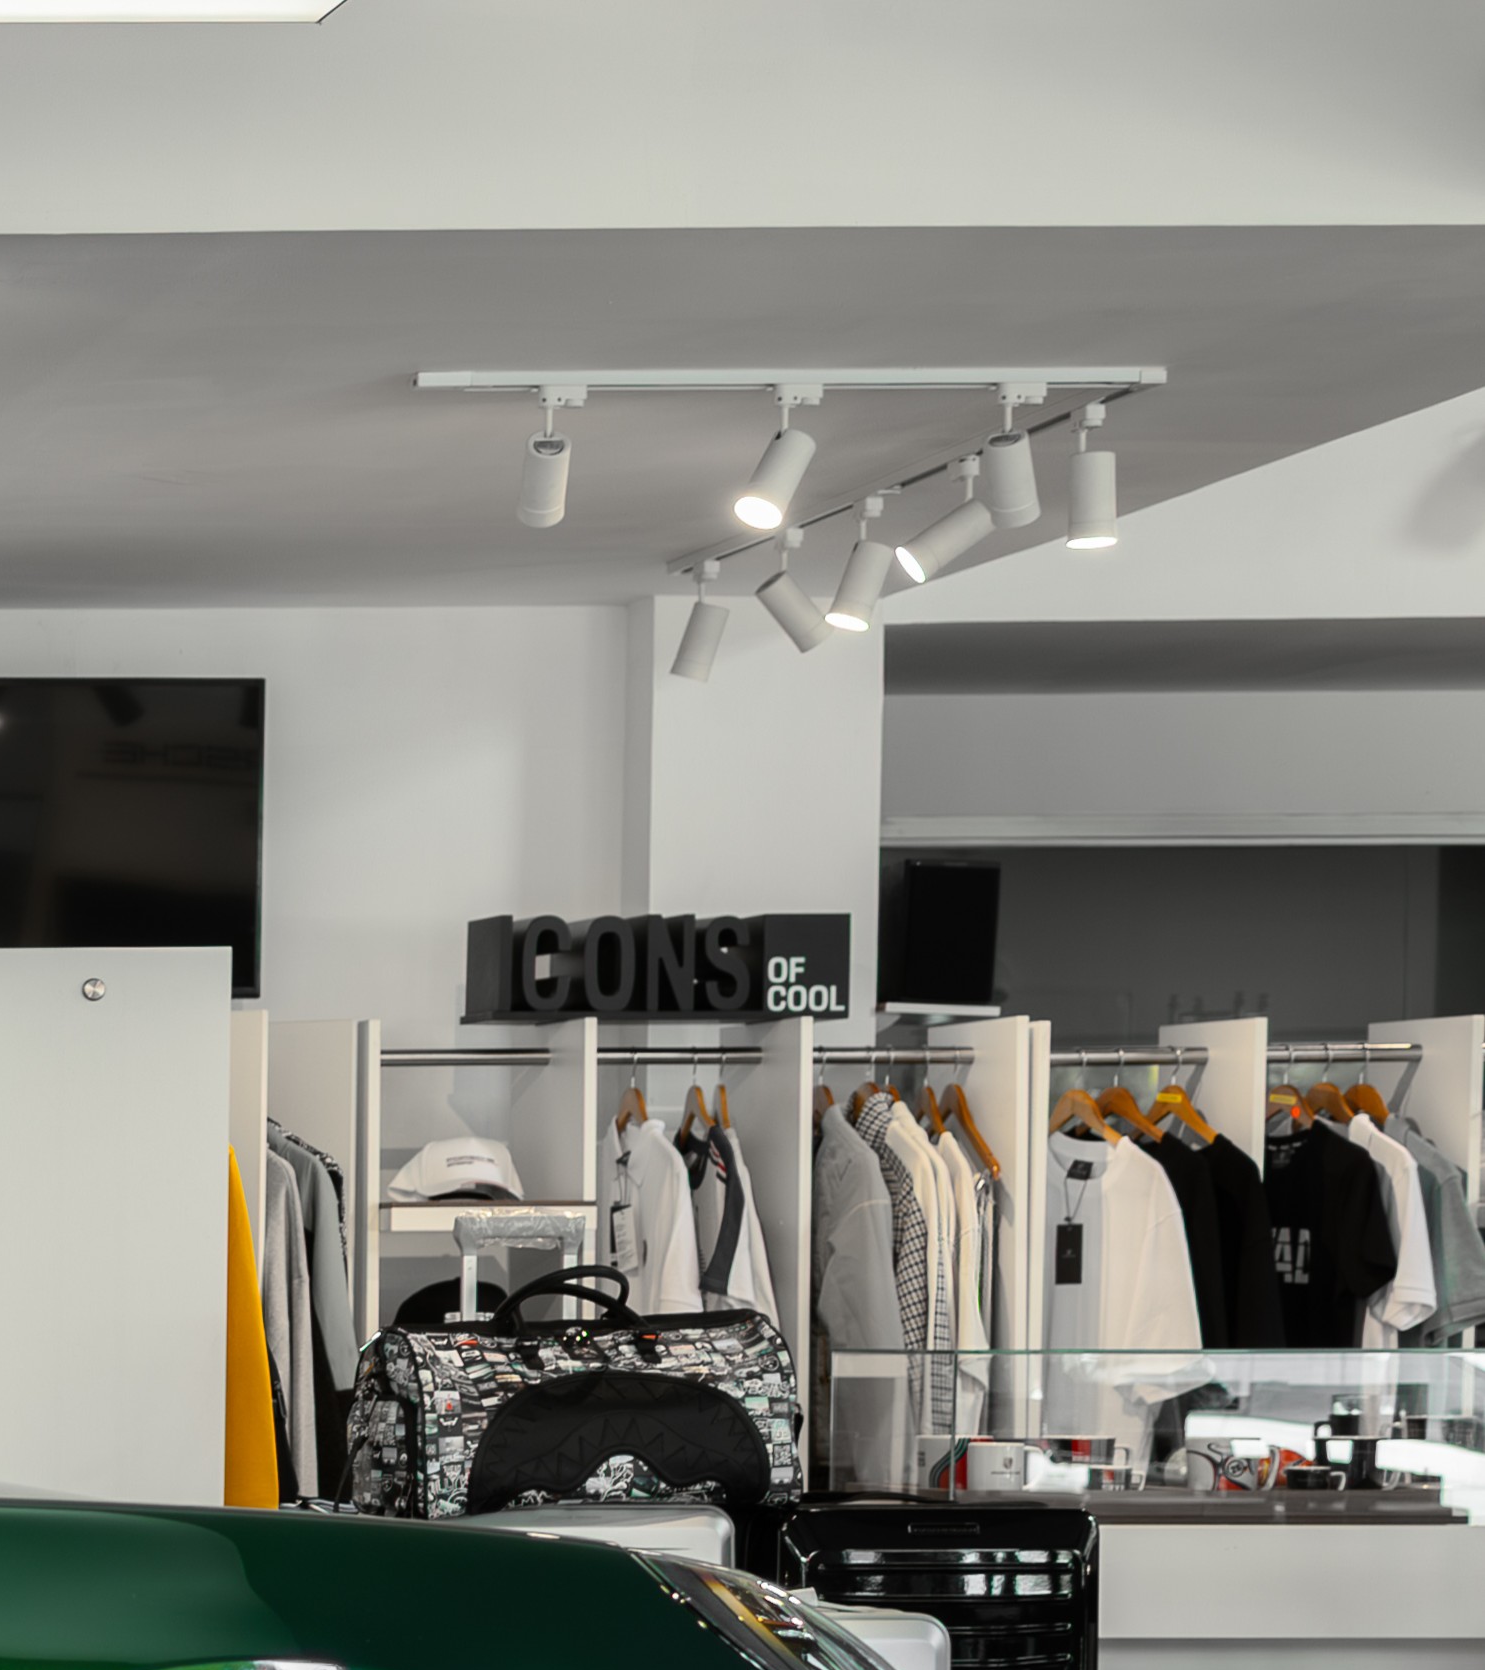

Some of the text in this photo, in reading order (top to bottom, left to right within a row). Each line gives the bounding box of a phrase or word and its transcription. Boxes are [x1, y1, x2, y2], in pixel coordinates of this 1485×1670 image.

[465, 914, 752, 1013] ICONS
[767, 956, 806, 984] OF
[767, 985, 846, 1013] COOL
